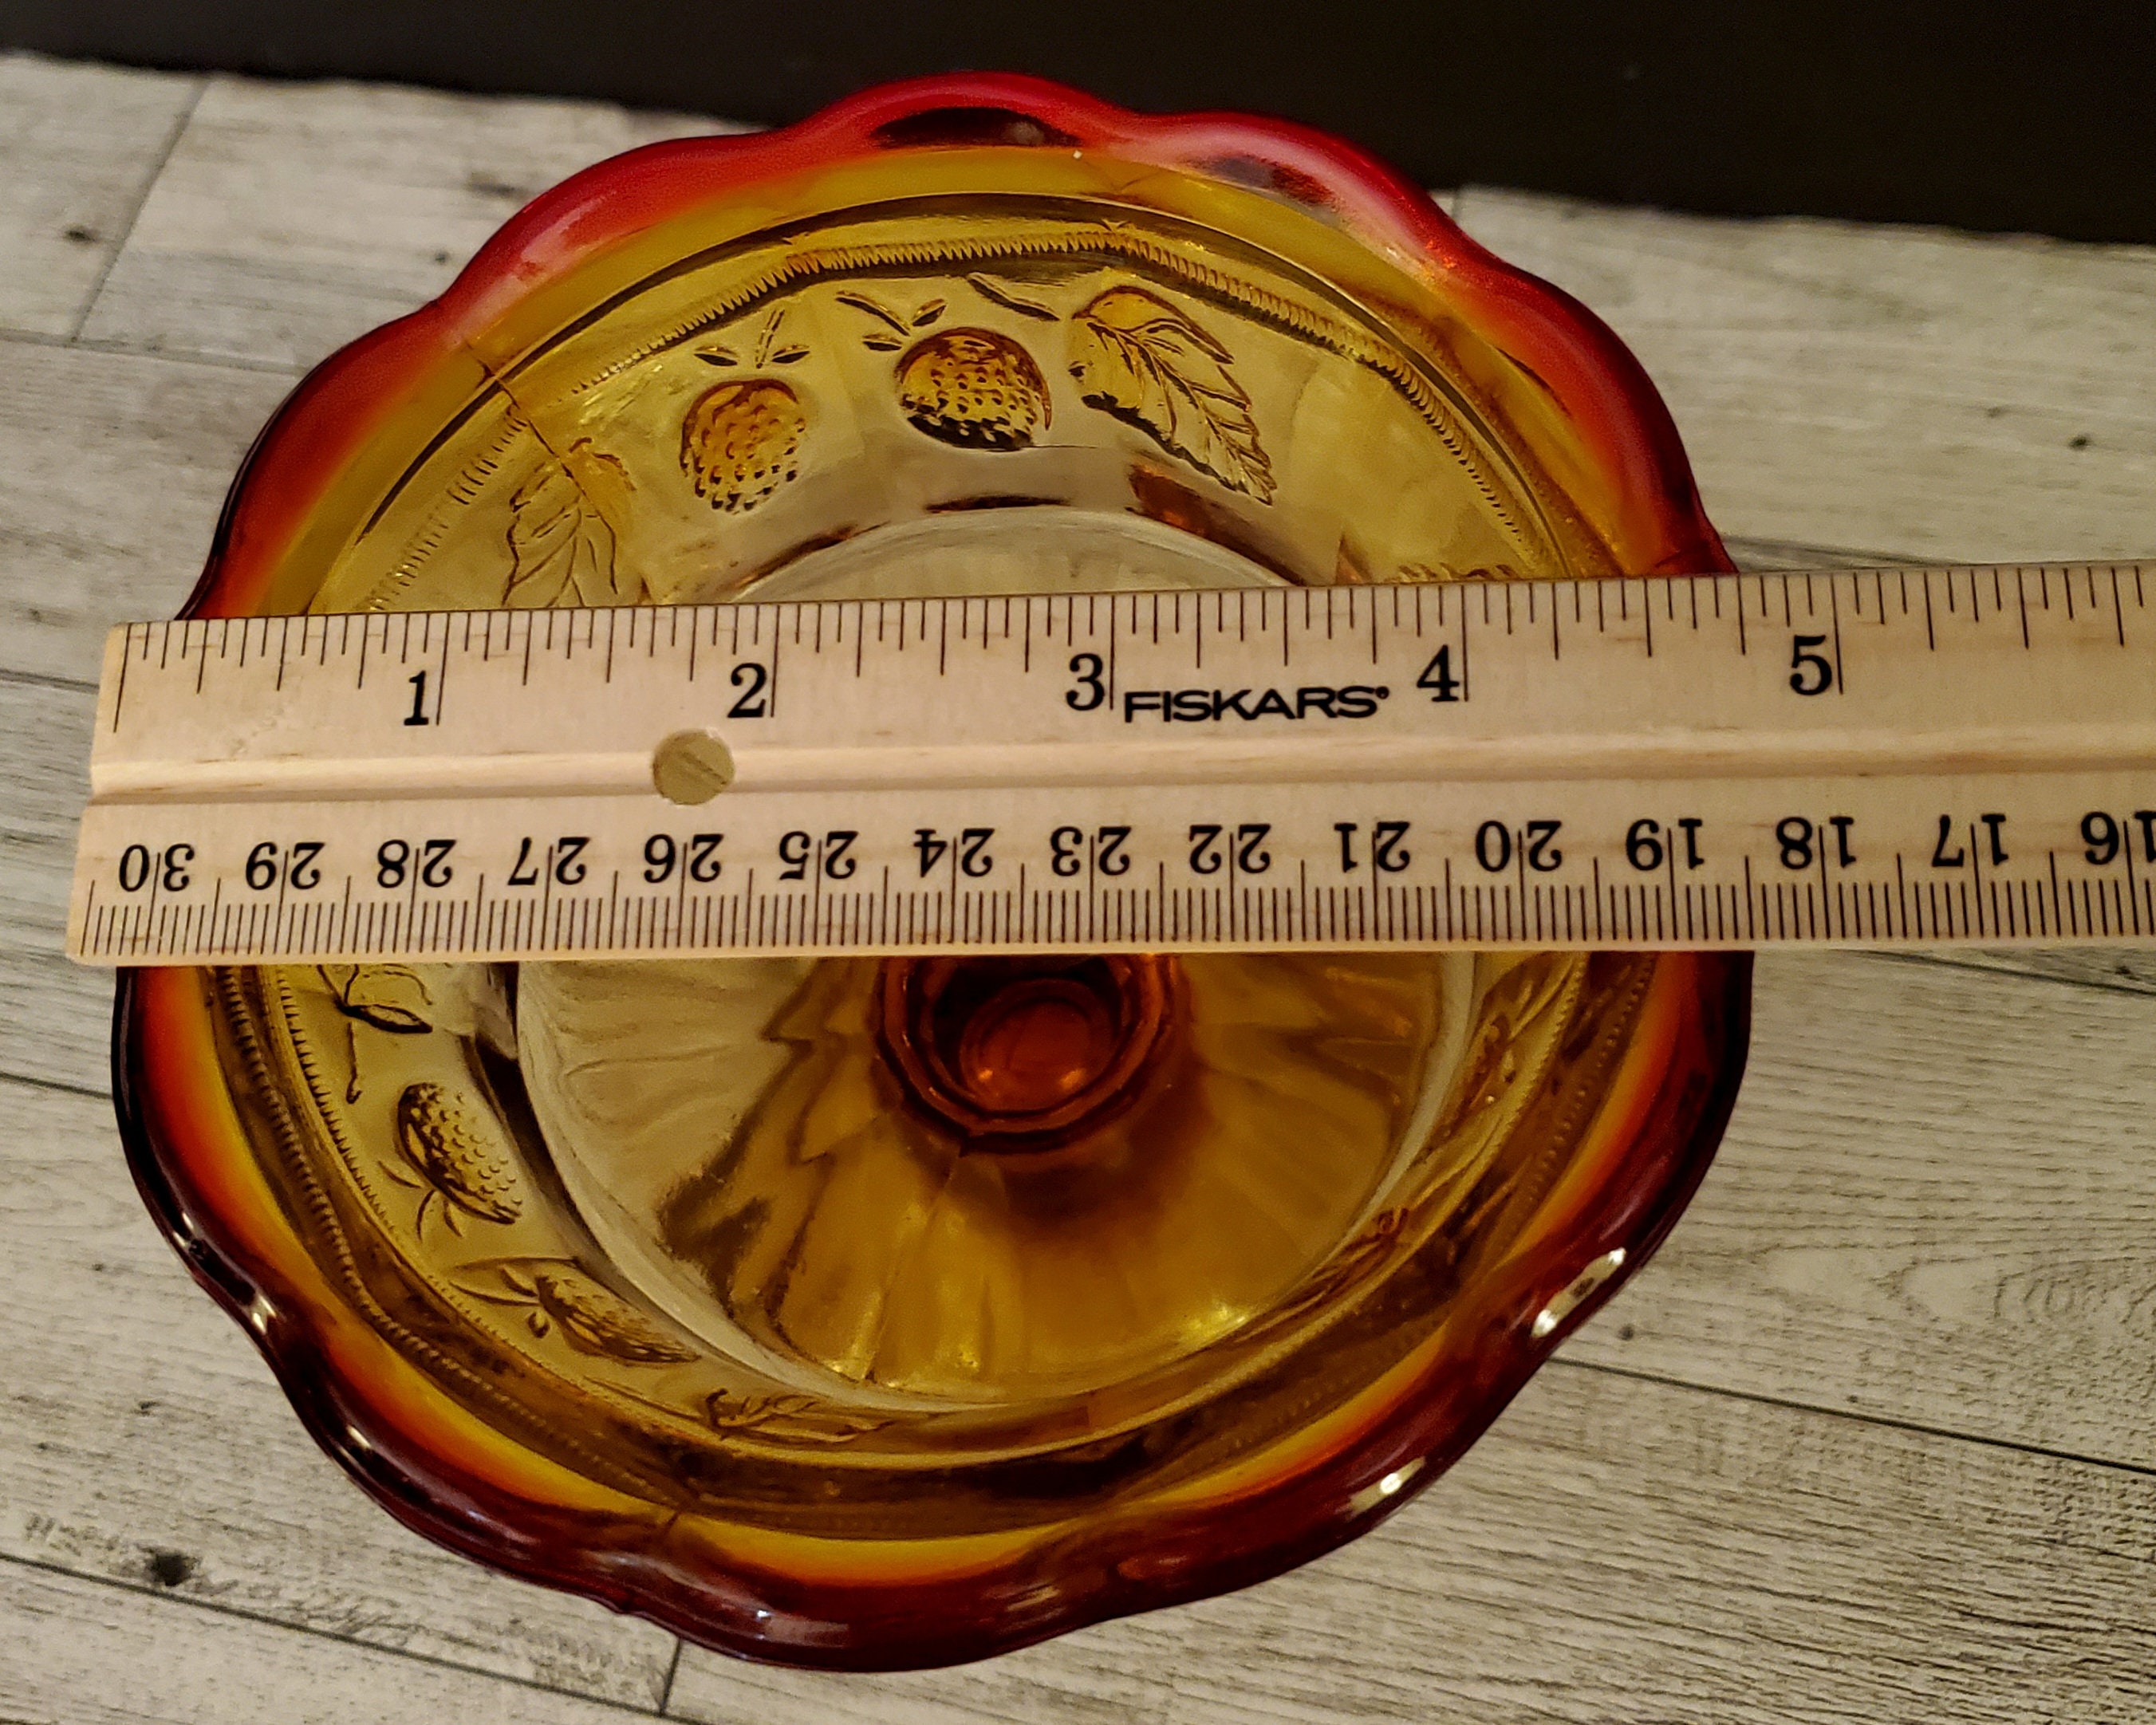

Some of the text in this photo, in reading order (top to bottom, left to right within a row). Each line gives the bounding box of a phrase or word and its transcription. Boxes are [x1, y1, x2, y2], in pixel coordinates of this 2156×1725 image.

[727, 662, 767, 719] 2
[1065, 652, 1106, 711] 3
[1416, 644, 1460, 703] 4
[1788, 633, 1834, 697] 5
[404, 671, 429, 727] 1
[245, 841, 325, 891] 29
[376, 839, 457, 888] 28
[507, 837, 590, 886] 27
[644, 833, 724, 884] 26
[778, 830, 859, 880] 25
[913, 828, 995, 878] 24
[1050, 826, 1132, 876] 23
[1188, 824, 1271, 875] 22
[1334, 821, 1412, 873] 21
[1475, 820, 1563, 872] 20
[1625, 817, 1705, 872] 19
[1775, 815, 1857, 871] 18
[1931, 813, 2009, 868] 17
[118, 843, 196, 892] 30
